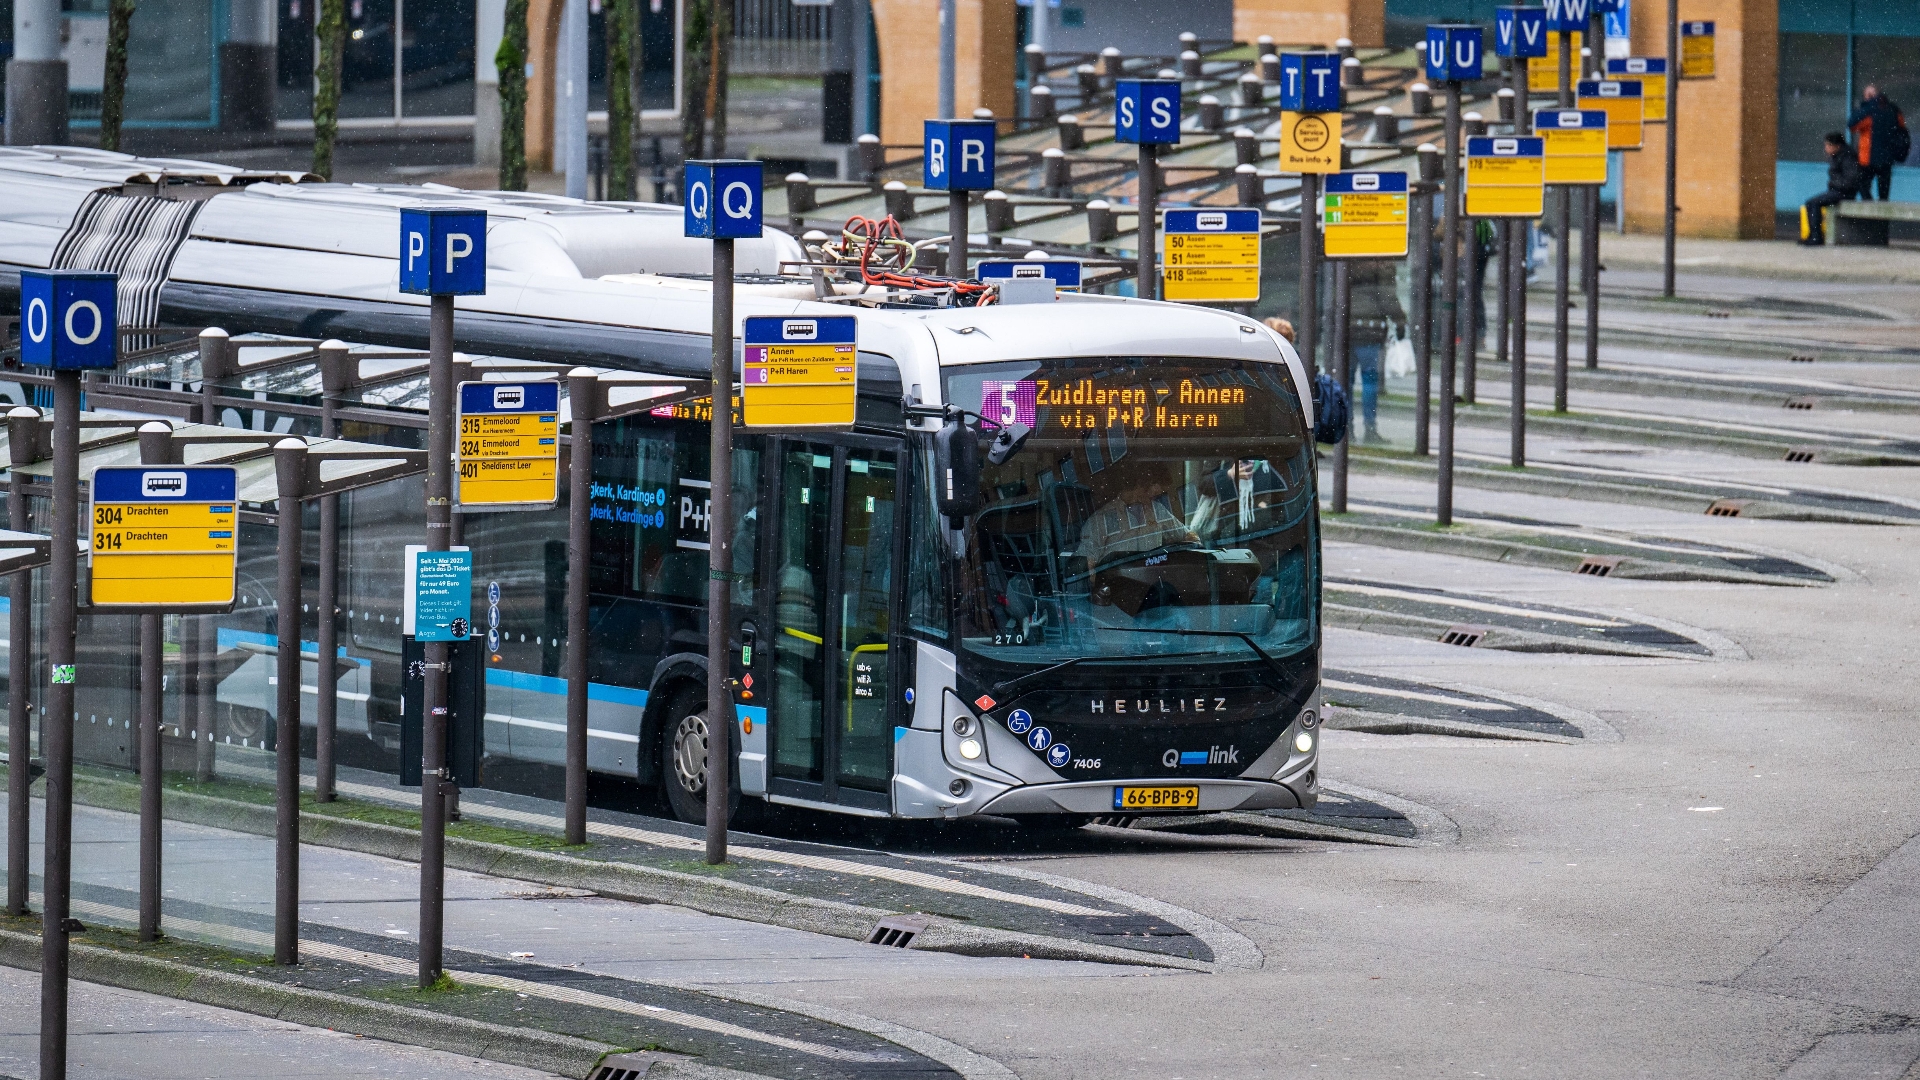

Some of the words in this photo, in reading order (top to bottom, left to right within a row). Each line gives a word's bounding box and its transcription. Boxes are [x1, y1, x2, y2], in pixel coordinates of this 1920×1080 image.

[1564, 0, 1587, 23] W
[1499, 20, 1512, 46] V
[1522, 20, 1540, 46] V
[1431, 40, 1444, 68] U
[1456, 40, 1475, 68] U
[1286, 68, 1299, 97] T
[1312, 68, 1332, 97] T
[1121, 96, 1134, 128] S
[1151, 97, 1171, 128] S
[931, 138, 945, 173] R
[962, 139, 985, 173] R
[1289, 155, 1304, 163] Bus
[1305, 155, 1321, 163] info
[690, 181, 707, 220] Q
[723, 181, 753, 220] Q
[1332, 211, 1342, 223] 11
[409, 231, 424, 272] P
[1172, 236, 1184, 248] 50
[446, 233, 473, 274] P
[1172, 253, 1183, 265] 51
[1166, 269, 1184, 281] 418
[64, 300, 103, 345] O
[760, 347, 768, 363] 5
[770, 347, 795, 355] Annen
[760, 368, 768, 383] 6
[1001, 382, 1017, 426] 5
[1036, 380, 1146, 405] Zuidlaren
[1180, 379, 1245, 405] Annen
[462, 418, 480, 434] 315
[483, 416, 520, 426] Emmeloord
[1060, 409, 1096, 428] via
[1107, 406, 1145, 428] P+R
[1156, 406, 1218, 428] Haren
[461, 441, 480, 456] 324
[482, 439, 520, 448] Emmeloord
[460, 463, 478, 478] 401
[482, 461, 516, 470] Sneldienst
[517, 461, 532, 470] Leer
[617, 485, 655, 507] Kardinge
[95, 508, 123, 525] 304
[127, 506, 169, 516] Drachten
[616, 507, 654, 528] Kardinge
[95, 533, 122, 550] 314
[126, 531, 168, 541] Drachten
[995, 634, 1023, 644] 270
[1091, 697, 1227, 714] HEULIEZ
[1073, 758, 1101, 769] 7406
[1127, 789, 1195, 804] 66-BPB-9
